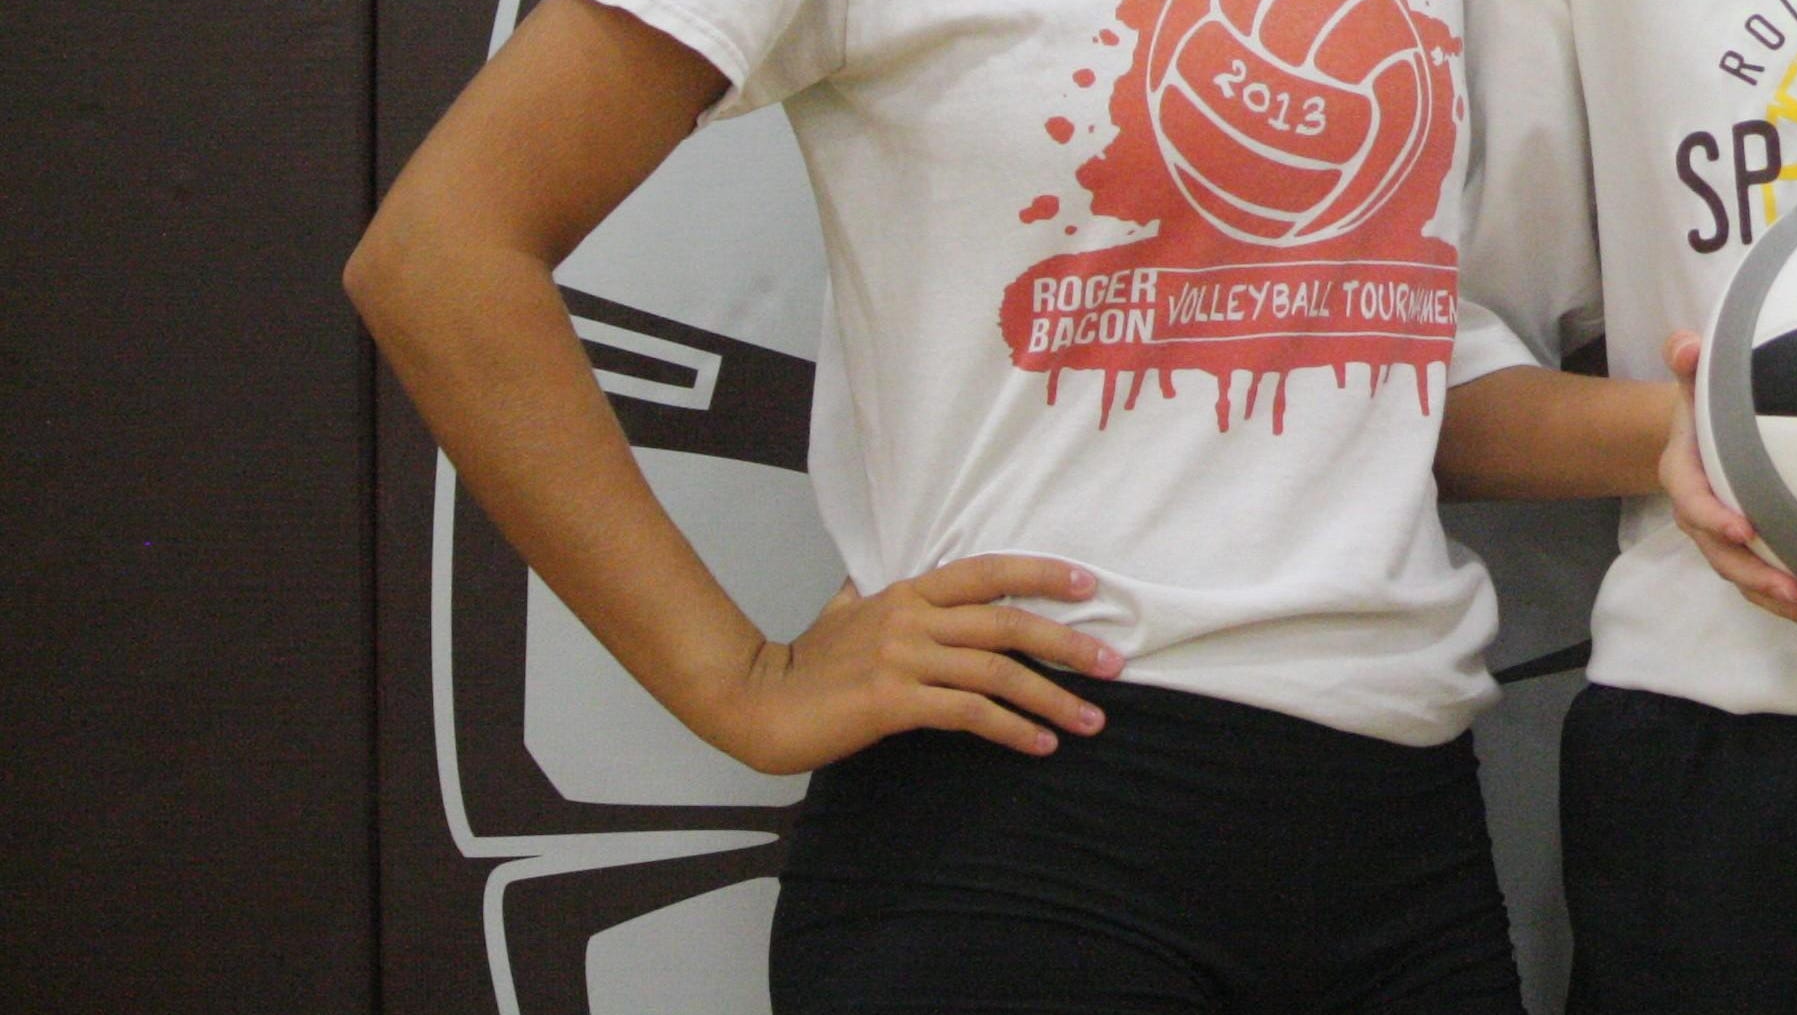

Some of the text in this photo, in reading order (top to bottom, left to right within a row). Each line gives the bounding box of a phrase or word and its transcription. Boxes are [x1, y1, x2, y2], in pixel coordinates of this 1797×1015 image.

[1213, 59, 1328, 136] 2013
[1033, 269, 1159, 314] ROGER
[1168, 280, 1458, 326] VOLLEYBALL TOURNAMEN
[1027, 309, 1156, 354] BACON
